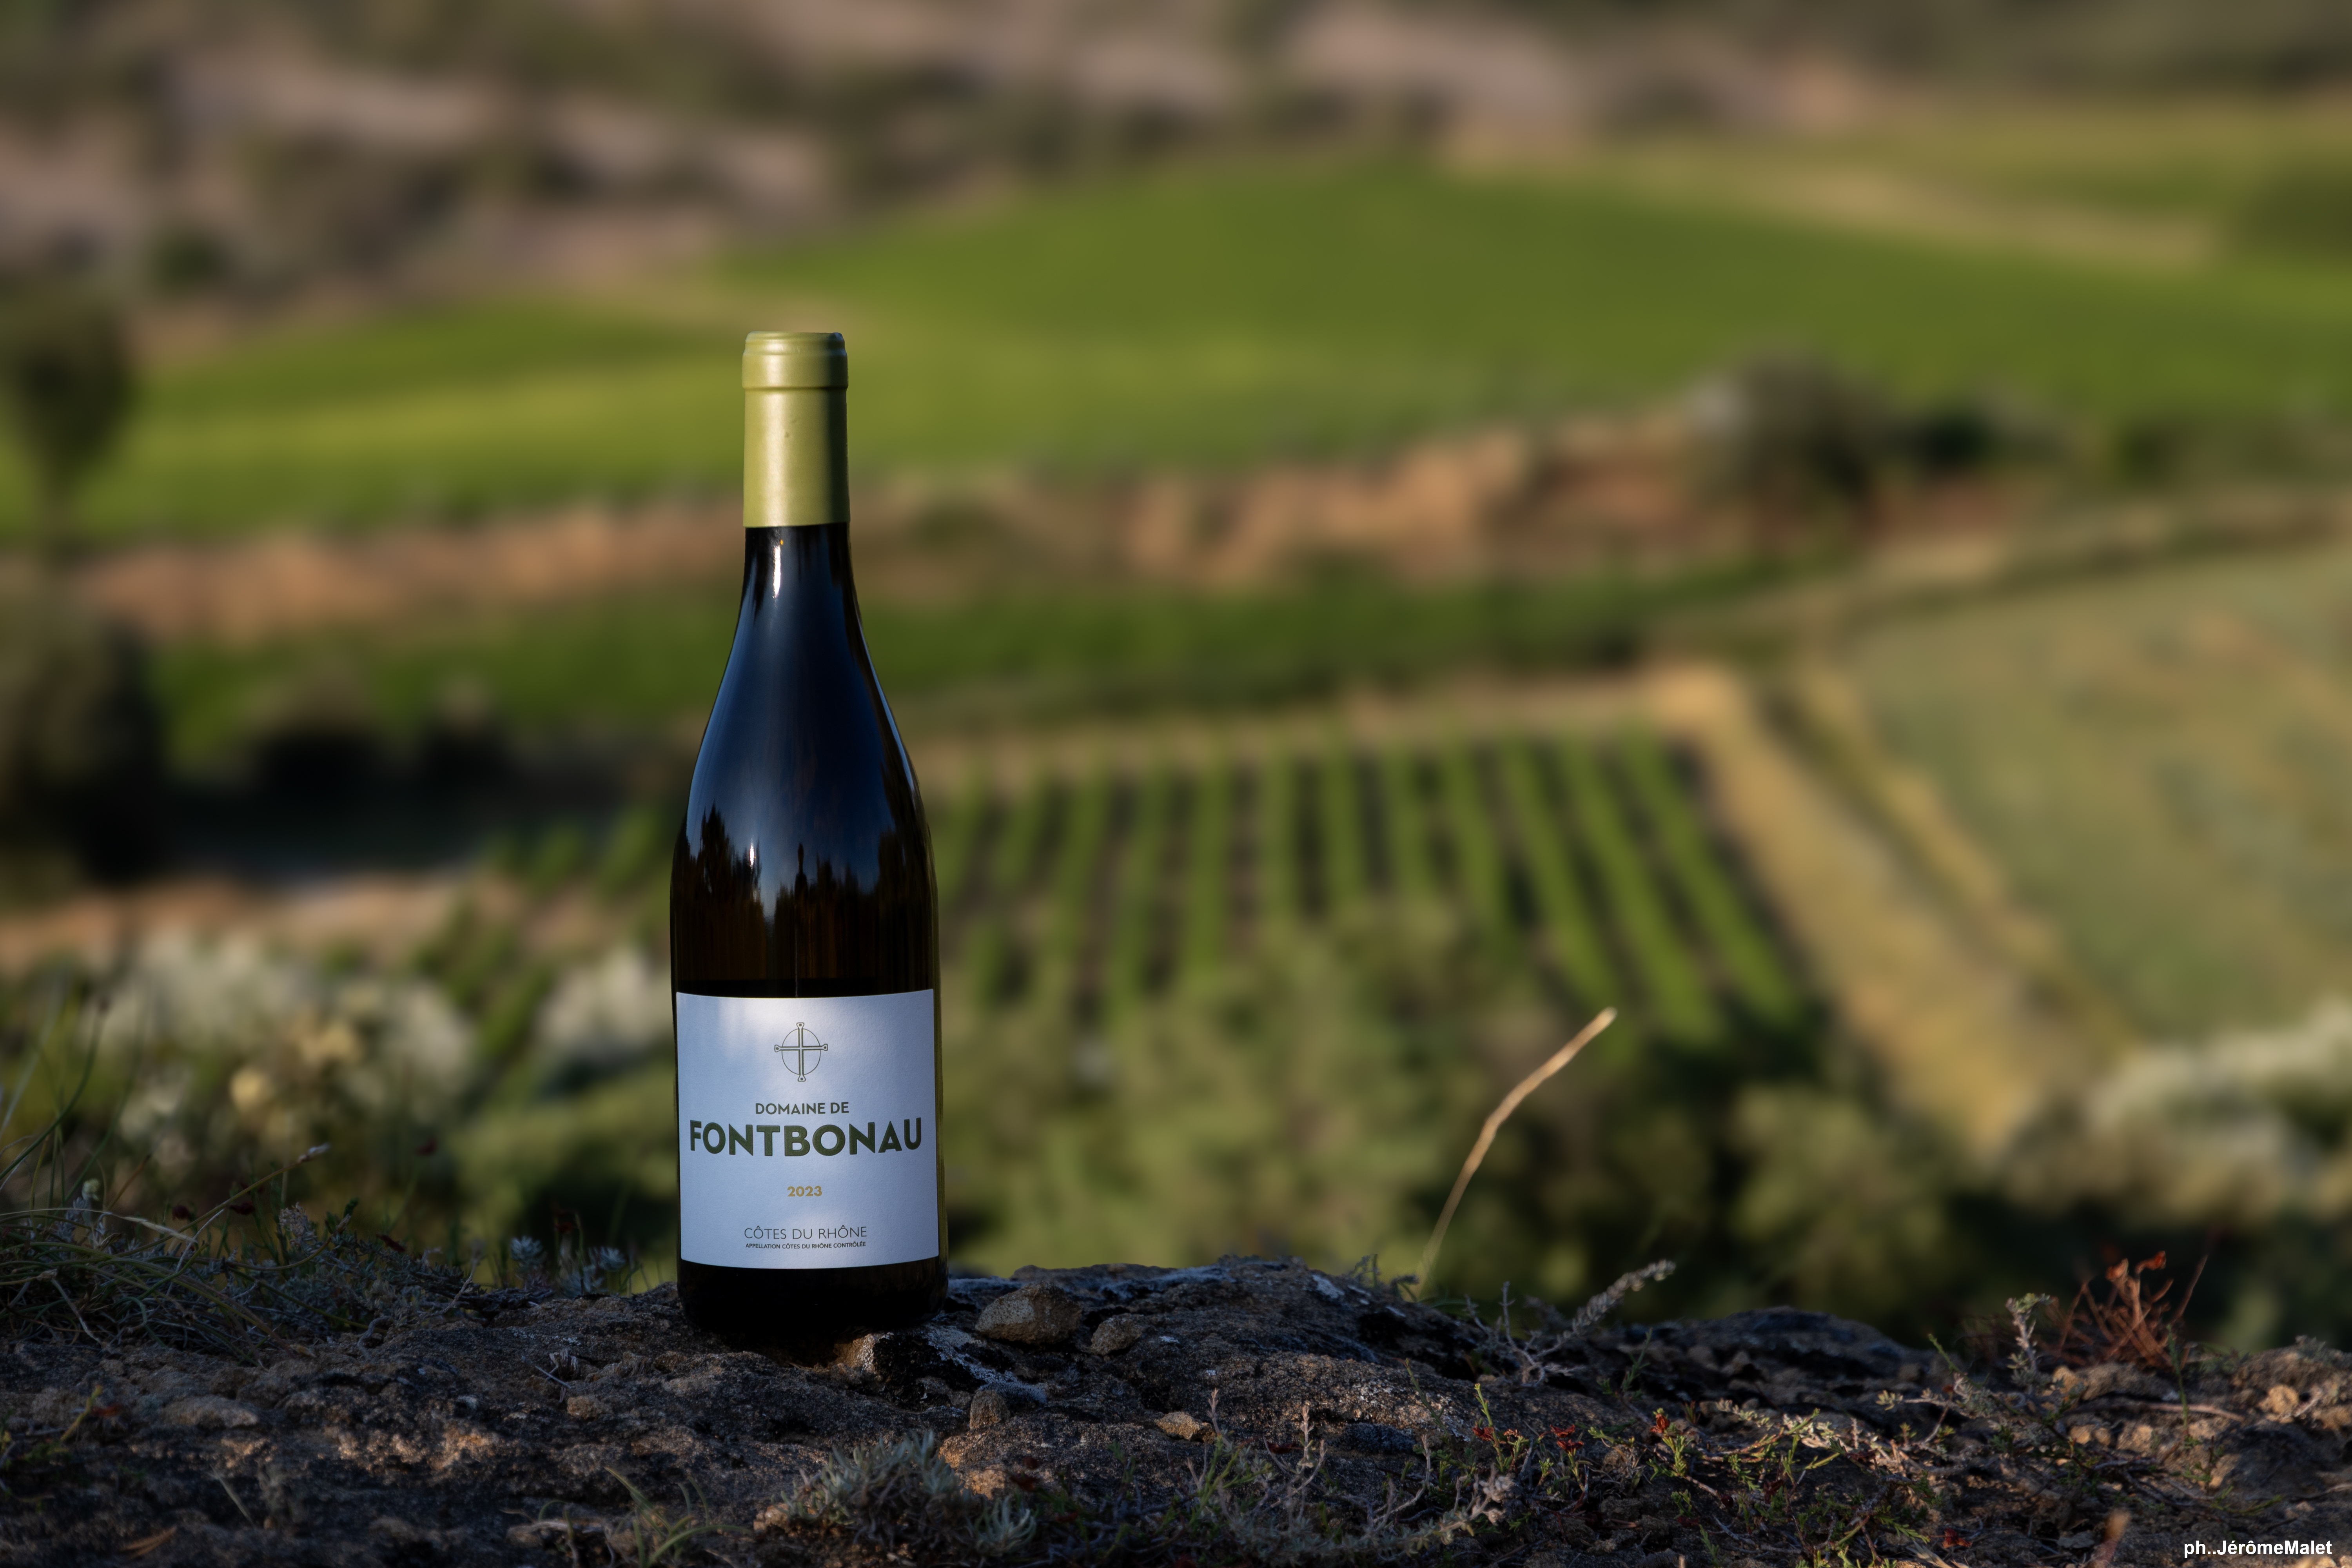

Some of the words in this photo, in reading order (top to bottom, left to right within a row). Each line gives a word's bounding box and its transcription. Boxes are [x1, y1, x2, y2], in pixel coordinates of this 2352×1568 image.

[755, 1102, 825, 1115] DOMAINE
[830, 1102, 849, 1114] DE
[690, 1117, 921, 1156] FONTBONAU
[787, 1186, 822, 1197] 2023
[744, 1226, 787, 1240] CÔTES
[792, 1229, 813, 1240] DU
[818, 1225, 867, 1239] RHÔNE
